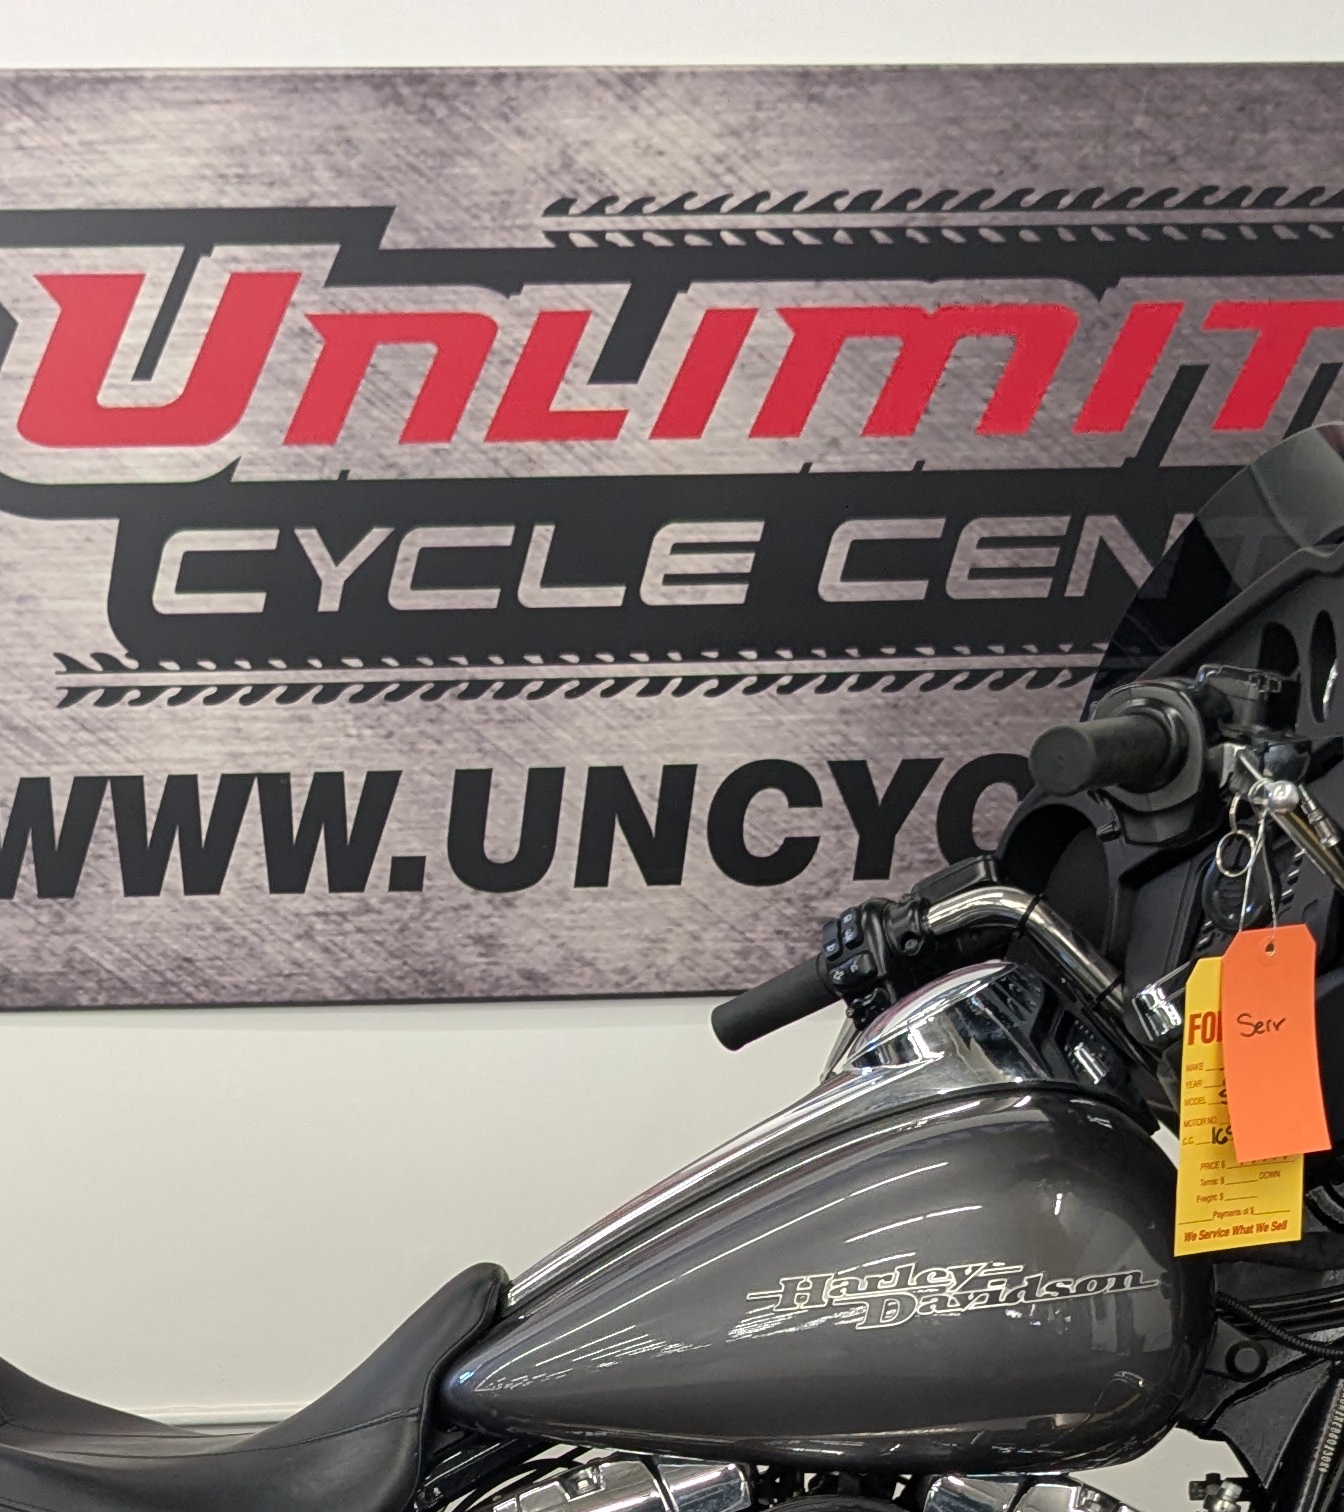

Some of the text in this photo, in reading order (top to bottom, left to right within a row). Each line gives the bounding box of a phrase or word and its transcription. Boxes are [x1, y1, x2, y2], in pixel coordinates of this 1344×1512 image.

[152, 520, 765, 616] CYCLE
[1236, 1012, 1287, 1038] Serv
[1184, 1219, 1289, 1243] We Service What We Sell
